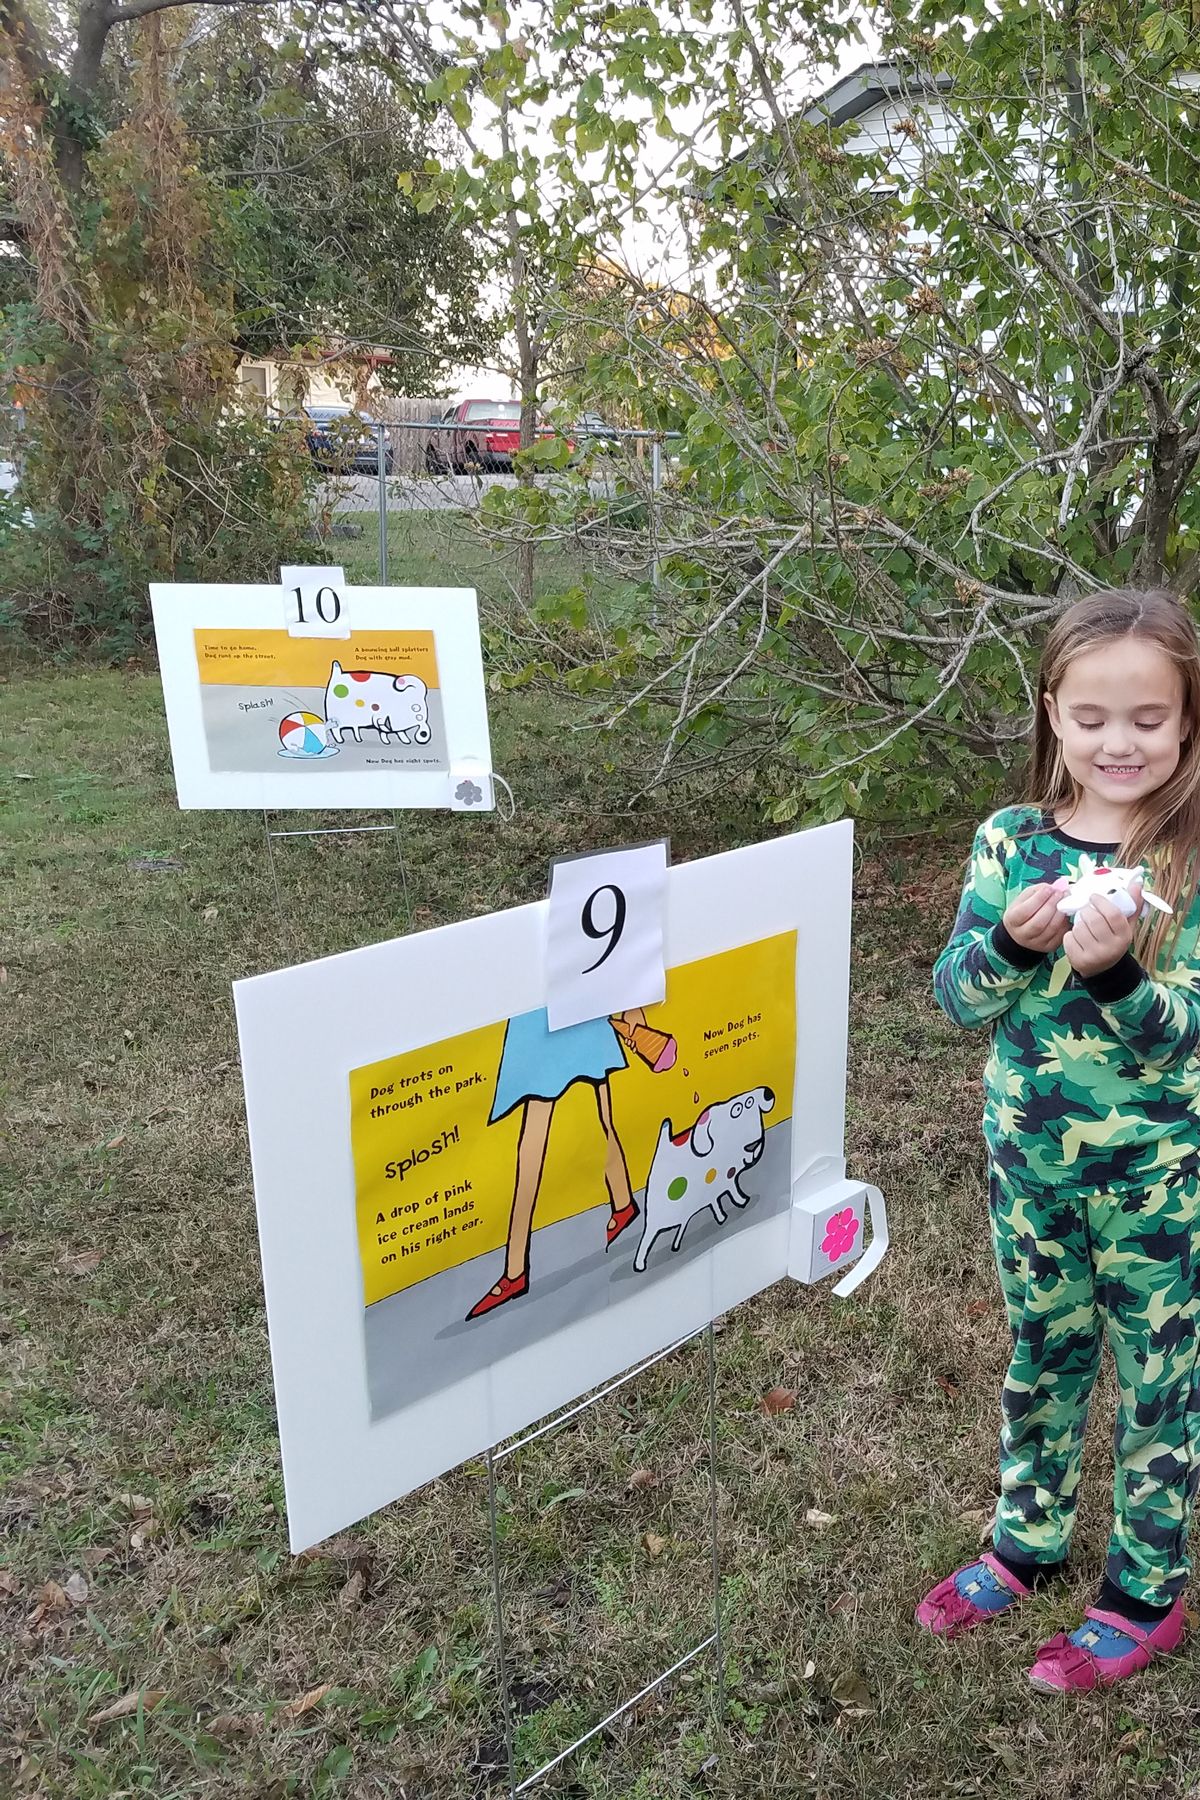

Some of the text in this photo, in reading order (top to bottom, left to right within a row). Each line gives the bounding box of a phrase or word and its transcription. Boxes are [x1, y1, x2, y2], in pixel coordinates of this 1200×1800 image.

[290, 586, 341, 624] 10
[581, 884, 627, 975] 9
[703, 1012, 762, 1042] Now Dog has
[704, 1031, 760, 1059] seven spots.
[370, 1064, 453, 1100] Dog trots on
[370, 1071, 487, 1119] through the park.
[385, 1124, 460, 1182] Splosh!
[376, 1179, 473, 1225] A drop of pink
[377, 1200, 475, 1245] ice cream lands
[381, 1218, 484, 1264] on his right ear.
